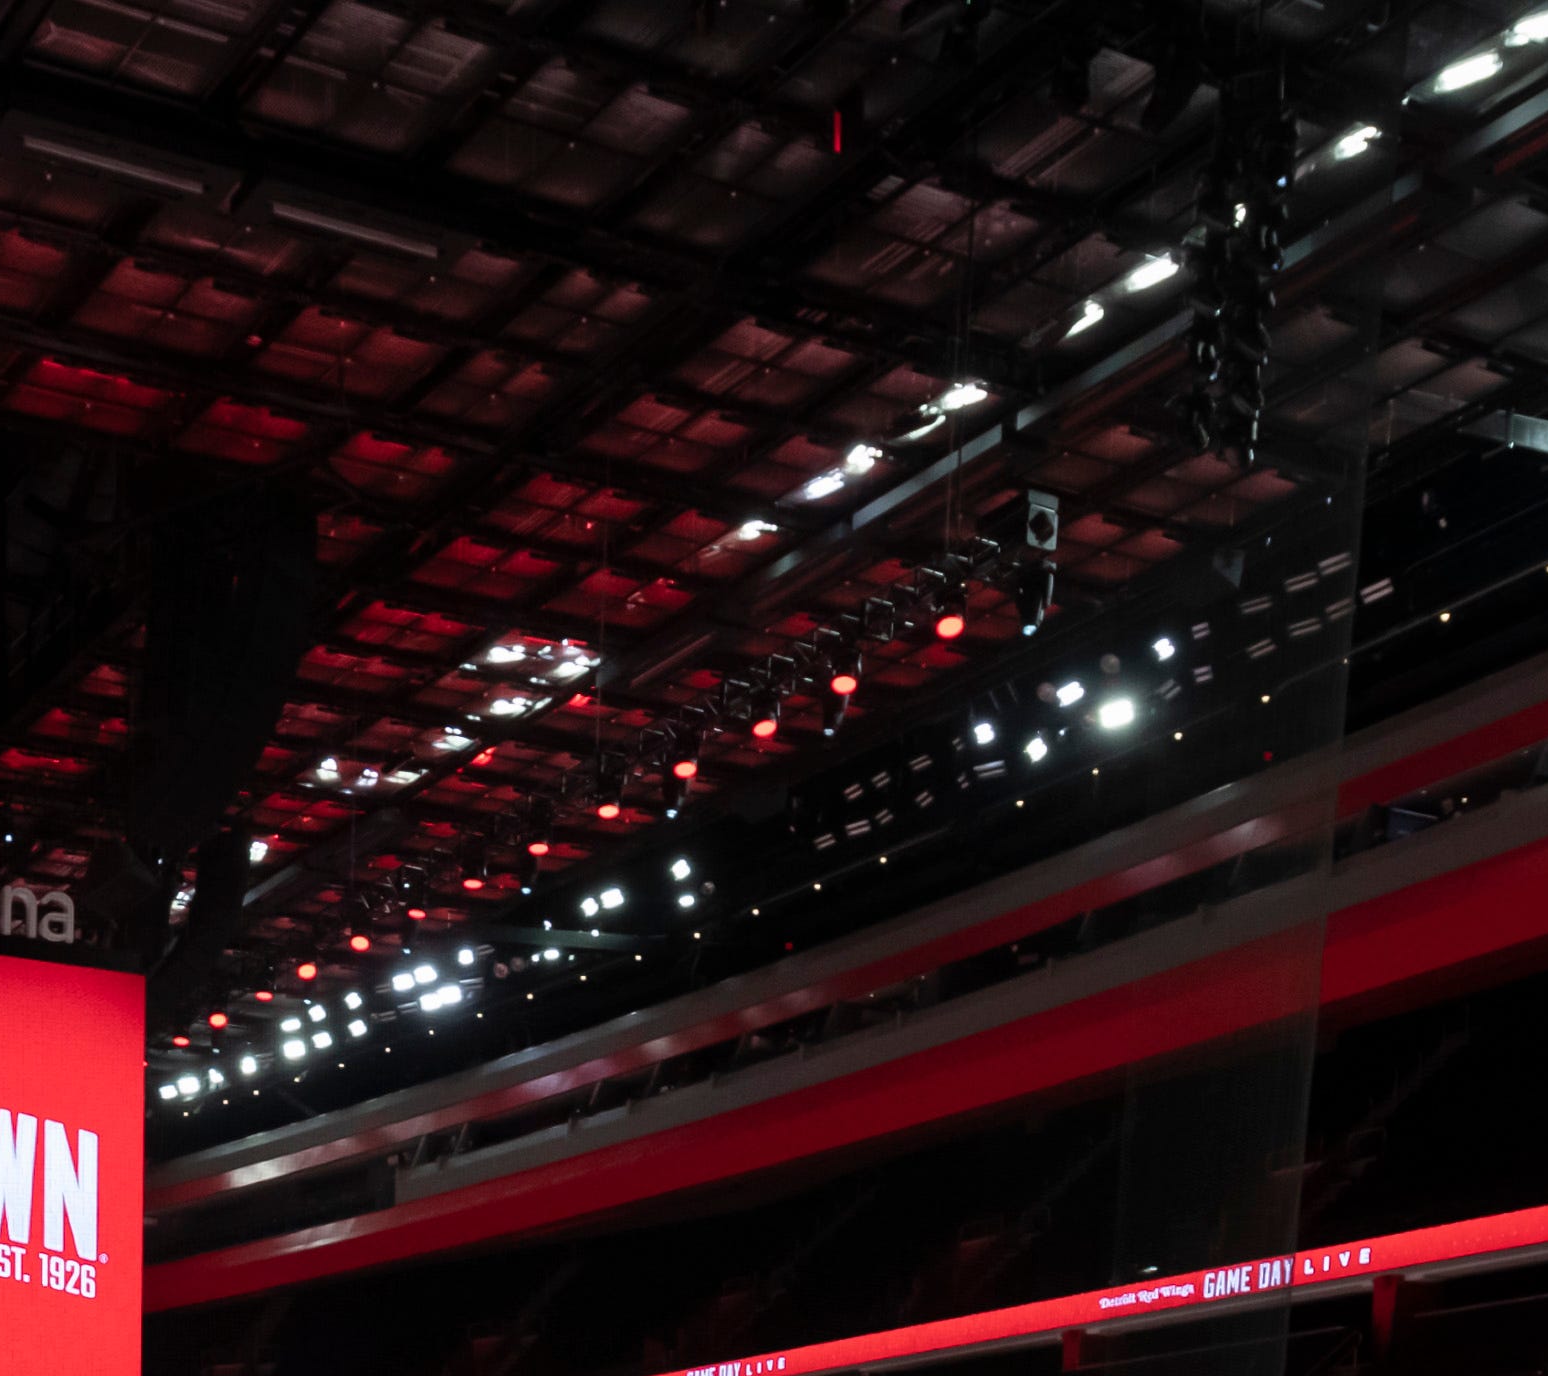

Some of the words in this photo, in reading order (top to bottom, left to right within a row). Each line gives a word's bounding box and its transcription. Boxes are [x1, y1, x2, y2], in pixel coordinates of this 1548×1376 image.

[38, 1252, 96, 1299] 1926
[1099, 1293, 1136, 1309] Detroit
[1138, 1290, 1160, 1304] Red
[1161, 1284, 1194, 1299] Wings
[1203, 1266, 1252, 1299] GAME
[1258, 1257, 1293, 1290] DAY
[1304, 1248, 1371, 1276] LIVE
[745, 1357, 786, 1376] LIVE
